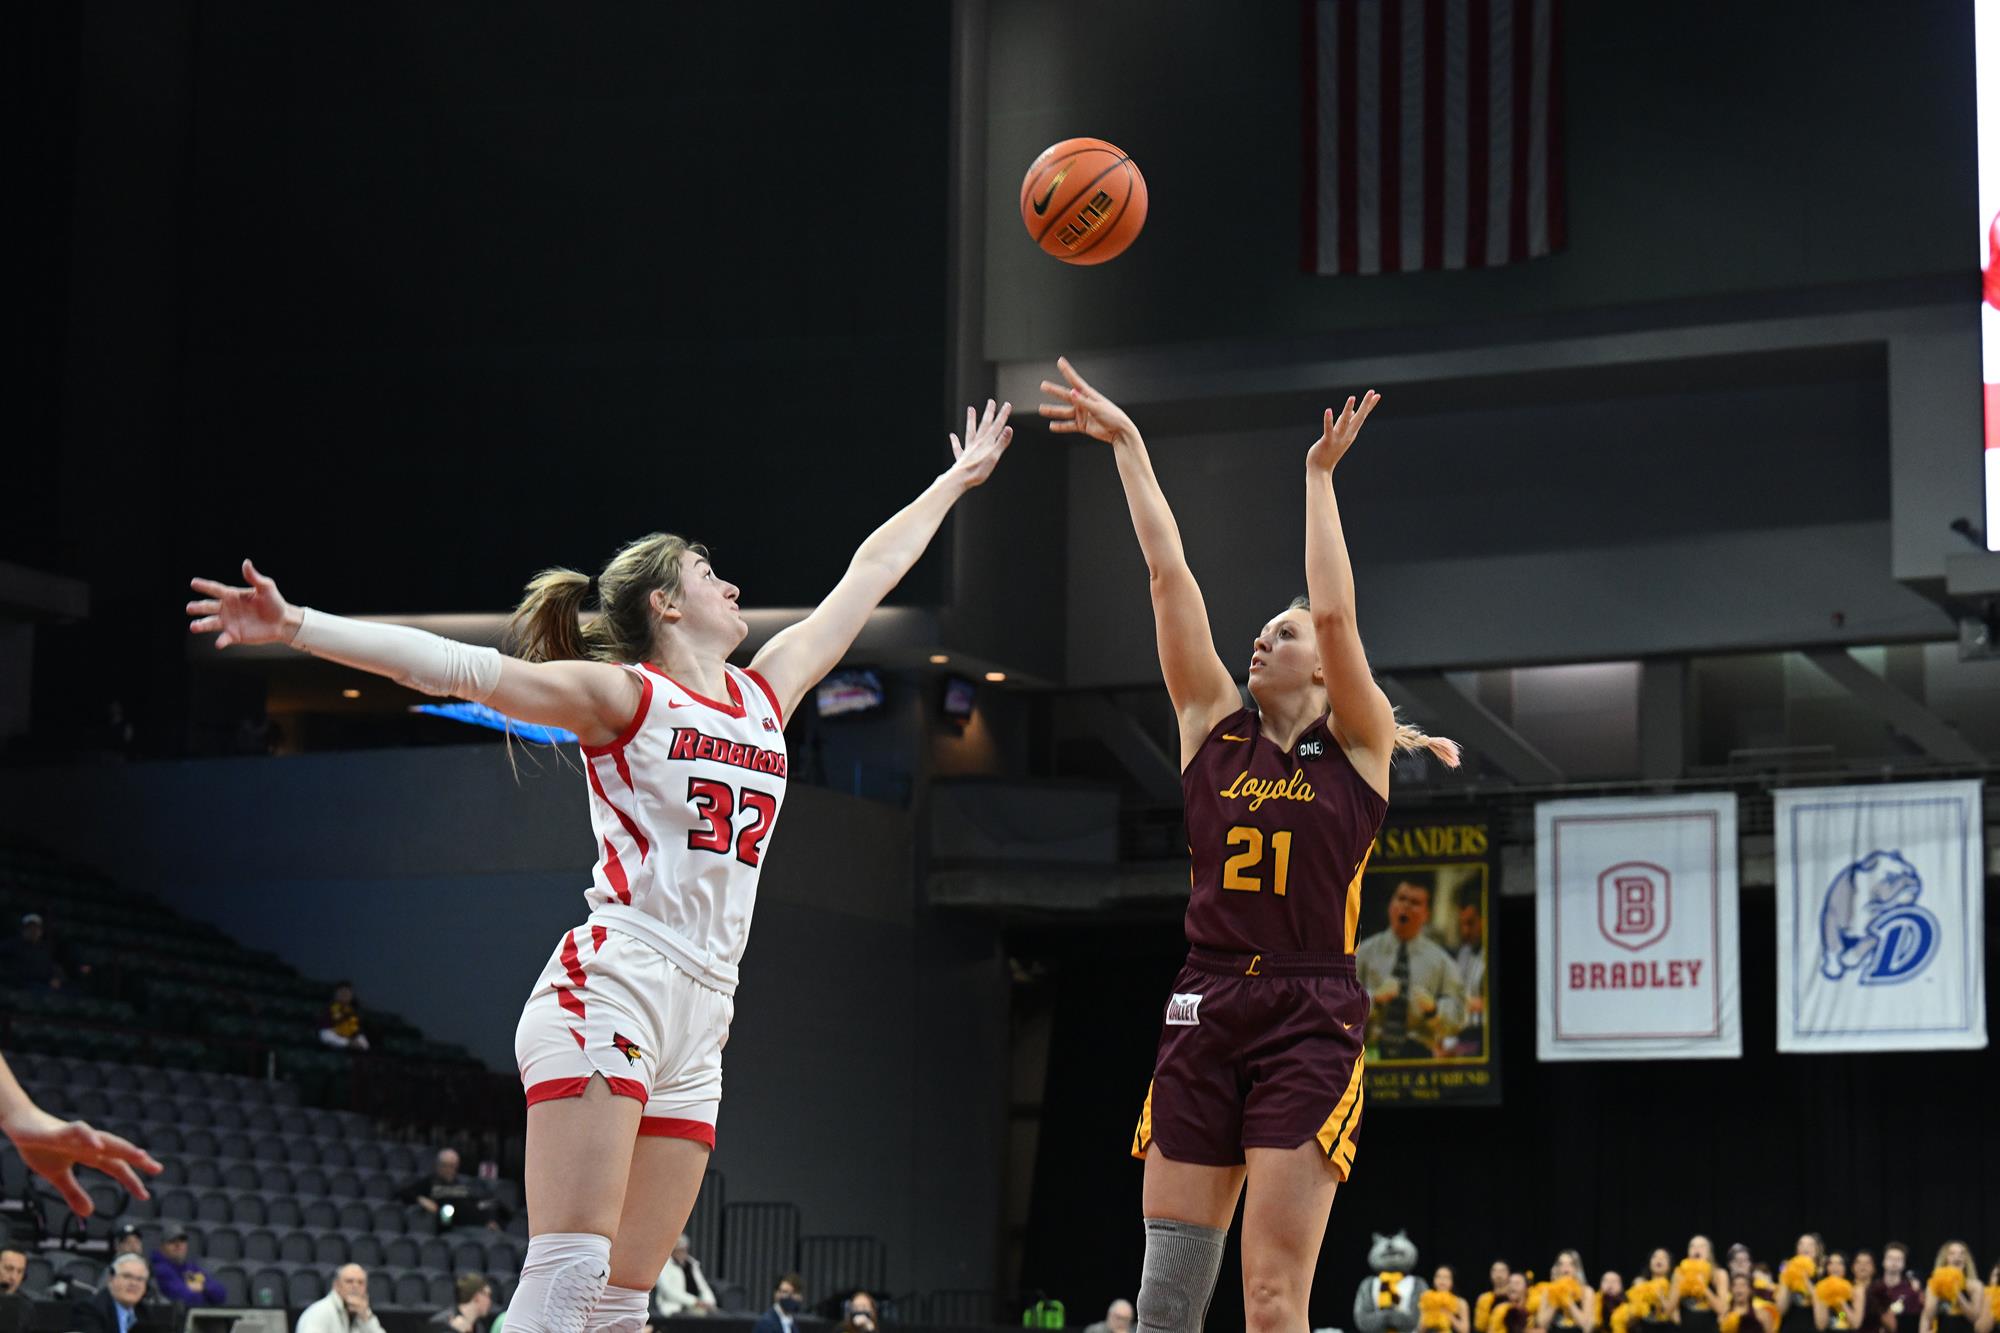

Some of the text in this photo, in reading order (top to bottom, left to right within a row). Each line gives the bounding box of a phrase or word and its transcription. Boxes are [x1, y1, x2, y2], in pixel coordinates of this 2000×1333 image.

[1055, 187, 1114, 251] ELITE
[1300, 742, 1321, 757] ONE
[1220, 768, 1316, 812] Loyola
[687, 776, 776, 868] 32
[1386, 825, 1489, 858] SANDERS
[1223, 826, 1292, 897] 21
[1613, 876, 1655, 935] B
[1859, 904, 1942, 986] D
[1569, 959, 1703, 991] BRADLEY
